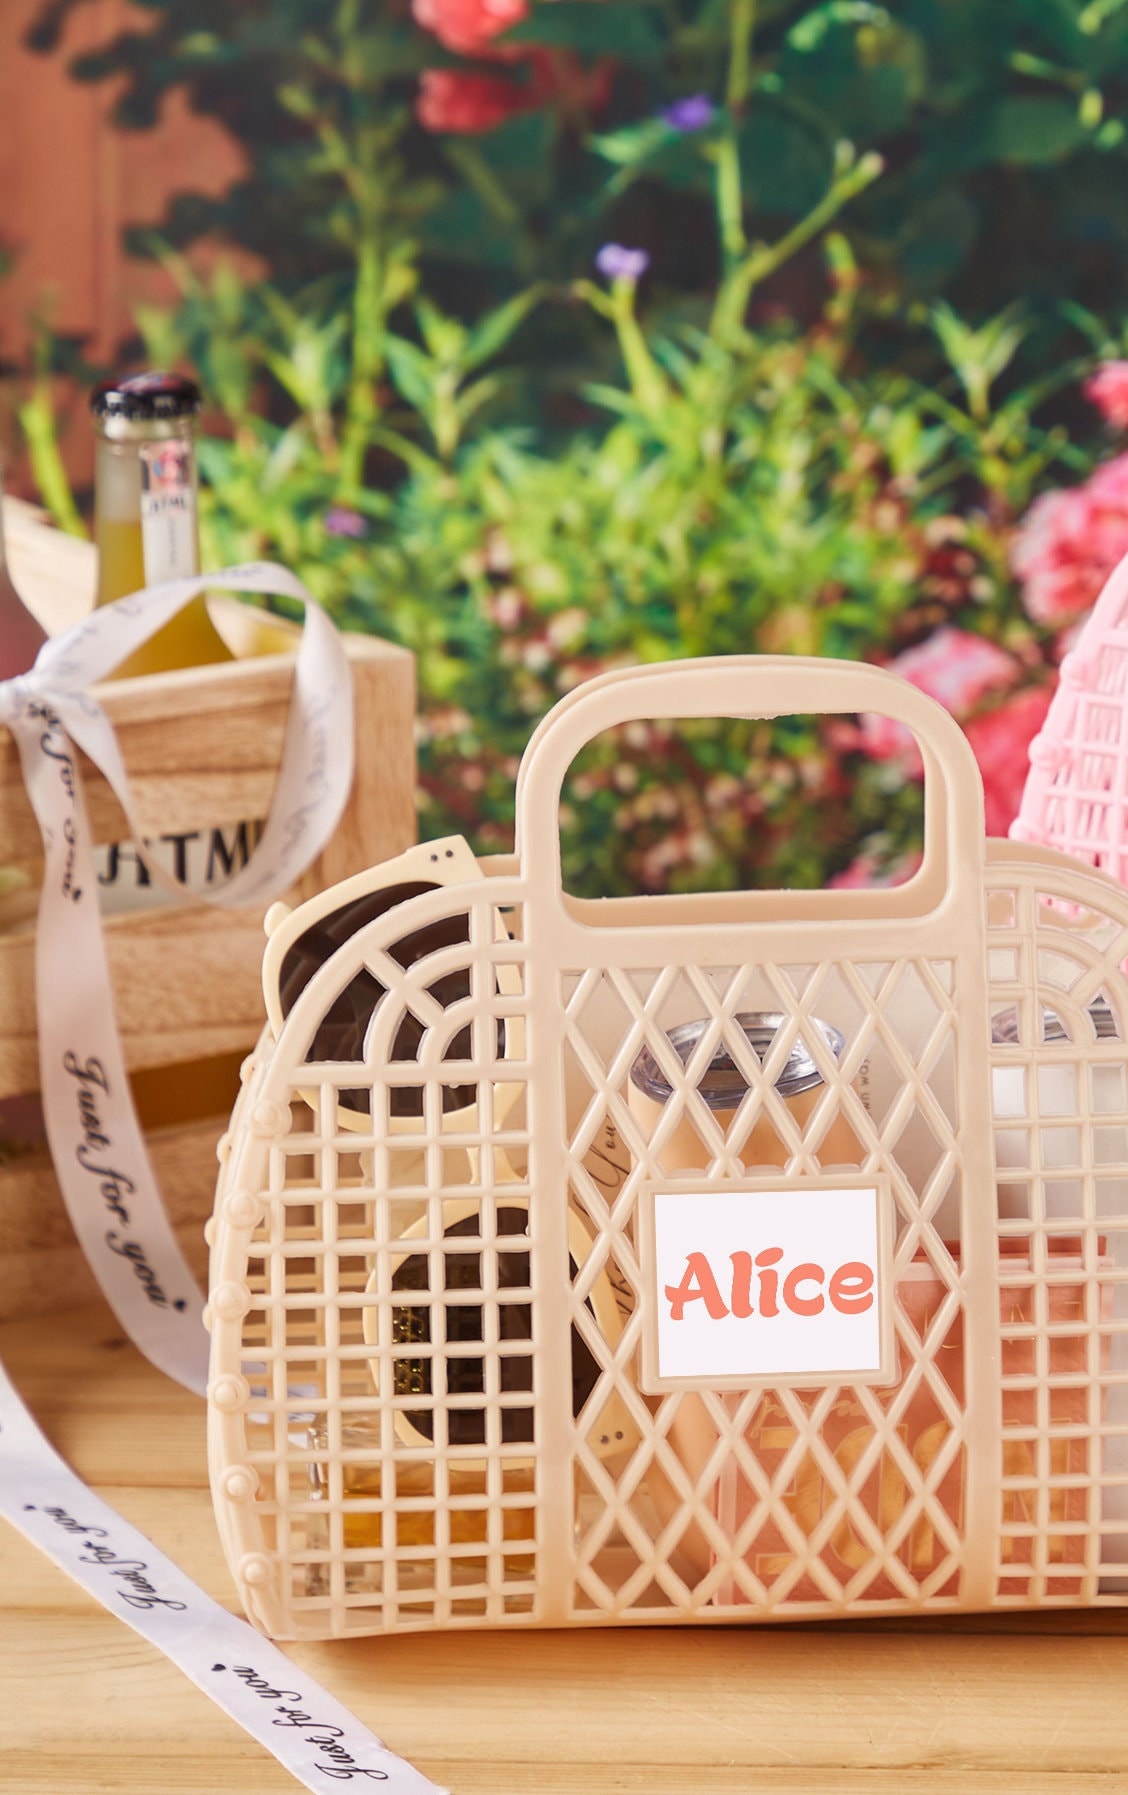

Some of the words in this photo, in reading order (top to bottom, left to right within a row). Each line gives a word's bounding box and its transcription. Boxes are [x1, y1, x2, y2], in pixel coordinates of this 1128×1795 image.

[63, 1050, 112, 1155] Just
[76, 1144, 137, 1231] for
[105, 1228, 170, 1310] you
[664, 1246, 875, 1321] Alice
[42, 1505, 108, 1540] you
[79, 1539, 148, 1572] for
[108, 1566, 188, 1611] Just
[231, 1664, 302, 1703] you
[271, 1704, 345, 1738] for
[304, 1732, 389, 1781] Just
